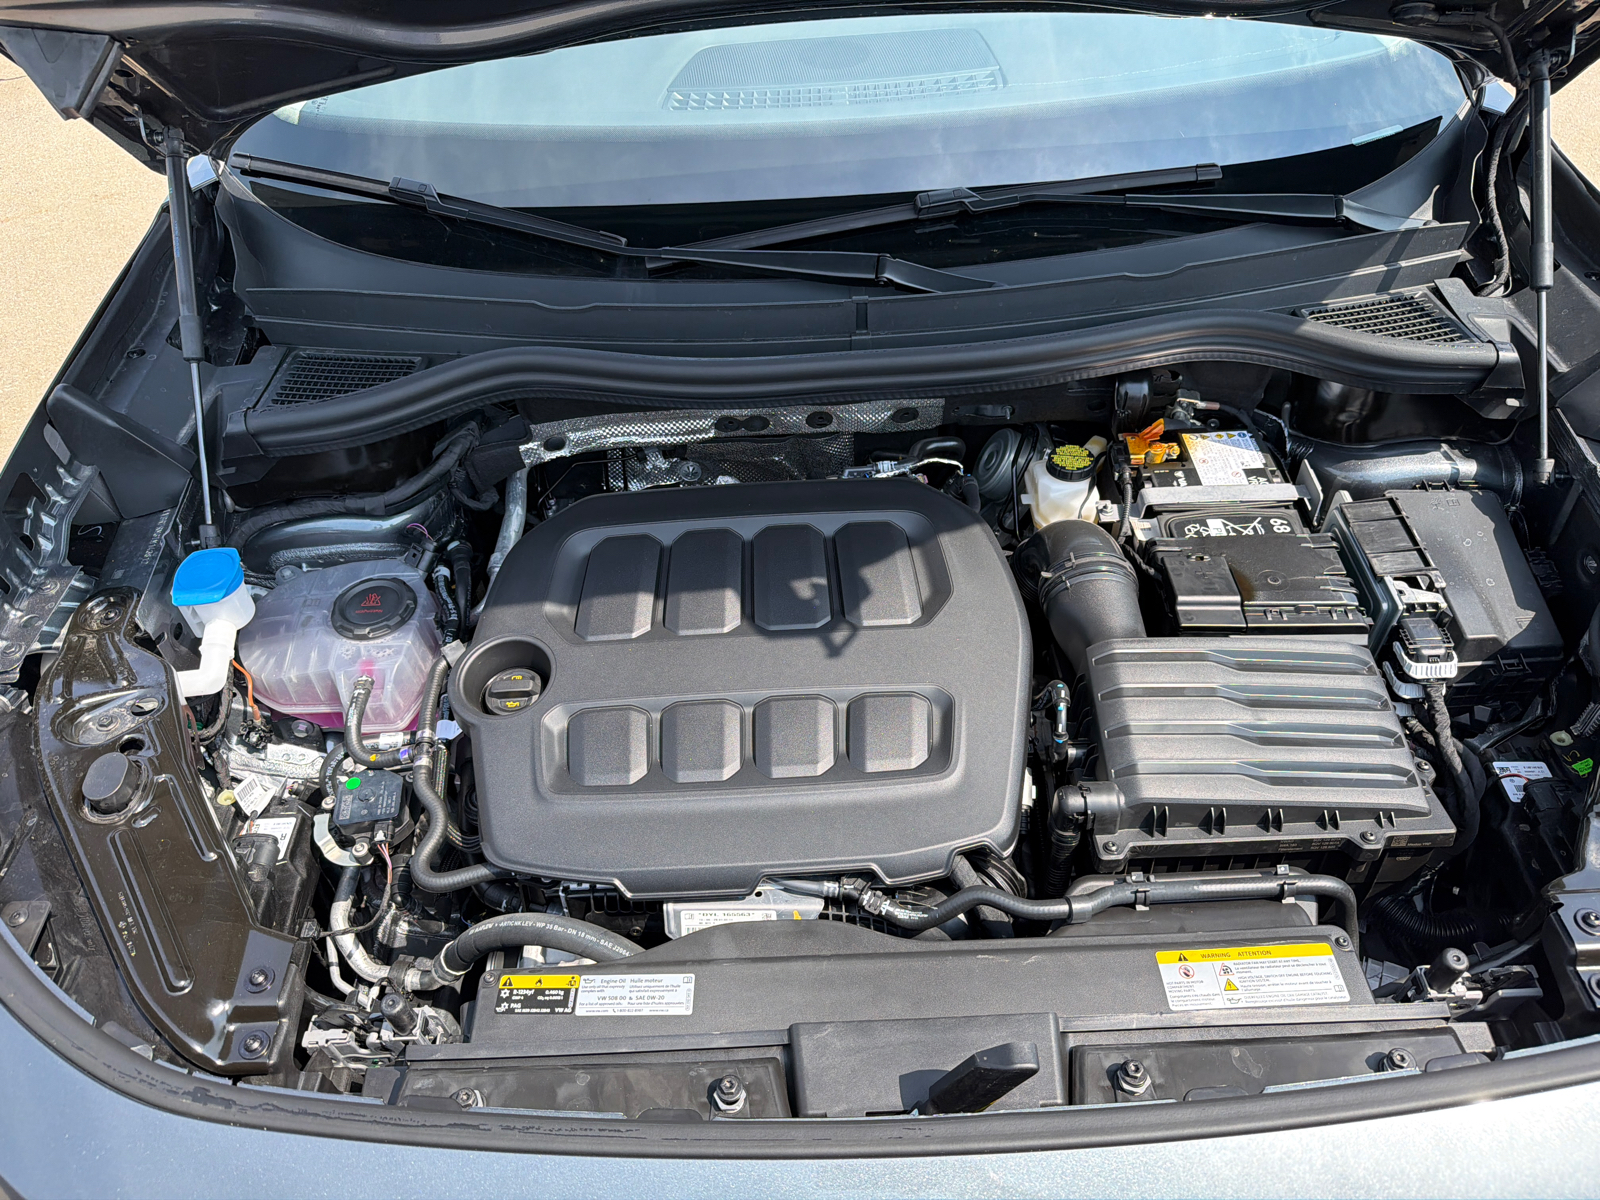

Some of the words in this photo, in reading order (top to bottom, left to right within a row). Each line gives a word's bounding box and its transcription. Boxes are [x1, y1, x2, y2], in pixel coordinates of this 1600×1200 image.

[1269, 518, 1291, 533] 68
[553, 924, 565, 932] Bar
[585, 934, 597, 942] mm
[599, 939, 613, 949] SAE
